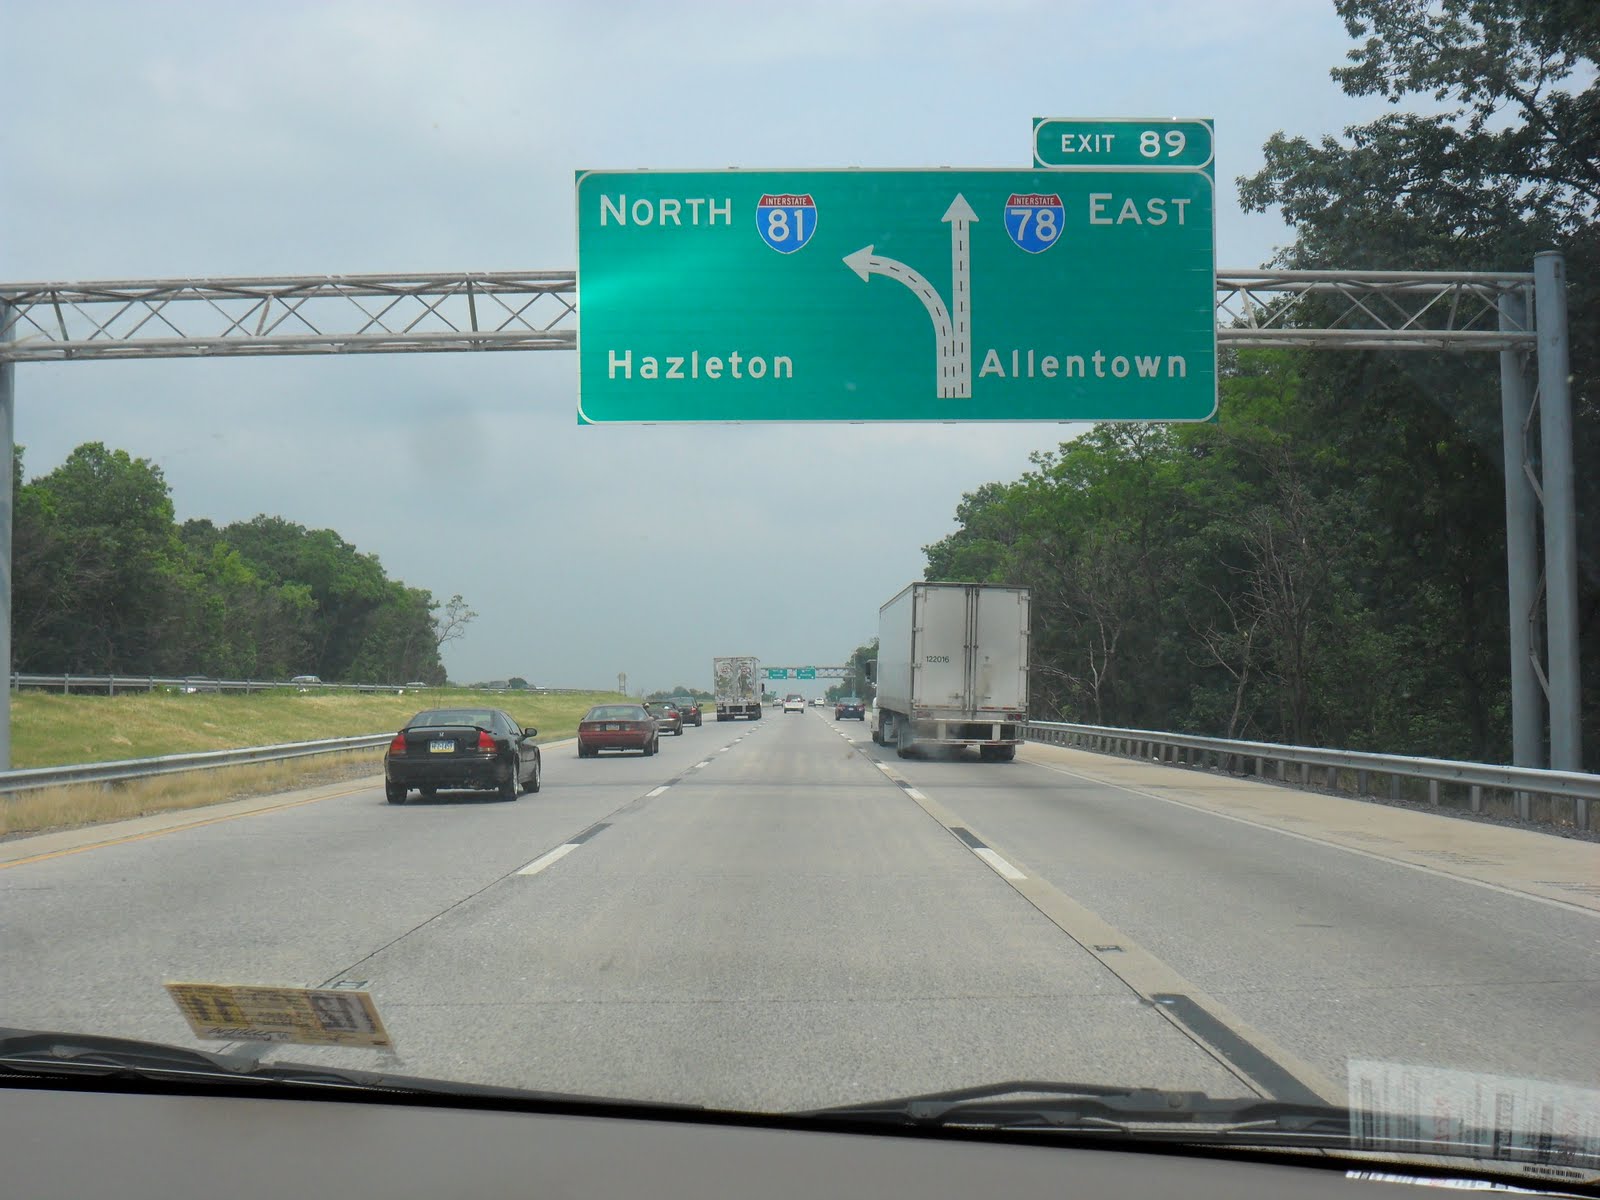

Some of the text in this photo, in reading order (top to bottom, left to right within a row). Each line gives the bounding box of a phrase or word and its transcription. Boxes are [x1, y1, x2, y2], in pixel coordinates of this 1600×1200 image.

[1061, 130, 1186, 158] EXIT 89
[600, 194, 732, 226] NORTH
[765, 197, 807, 206] INTERSTATE
[1013, 197, 1055, 206] INTERSTATE
[1089, 193, 1191, 226] EAST
[767, 209, 803, 242] 81
[1010, 208, 1057, 242] 78
[608, 350, 793, 379] Hazleton
[978, 349, 1187, 378] Allentown
[926, 655, 950, 663] 122016
